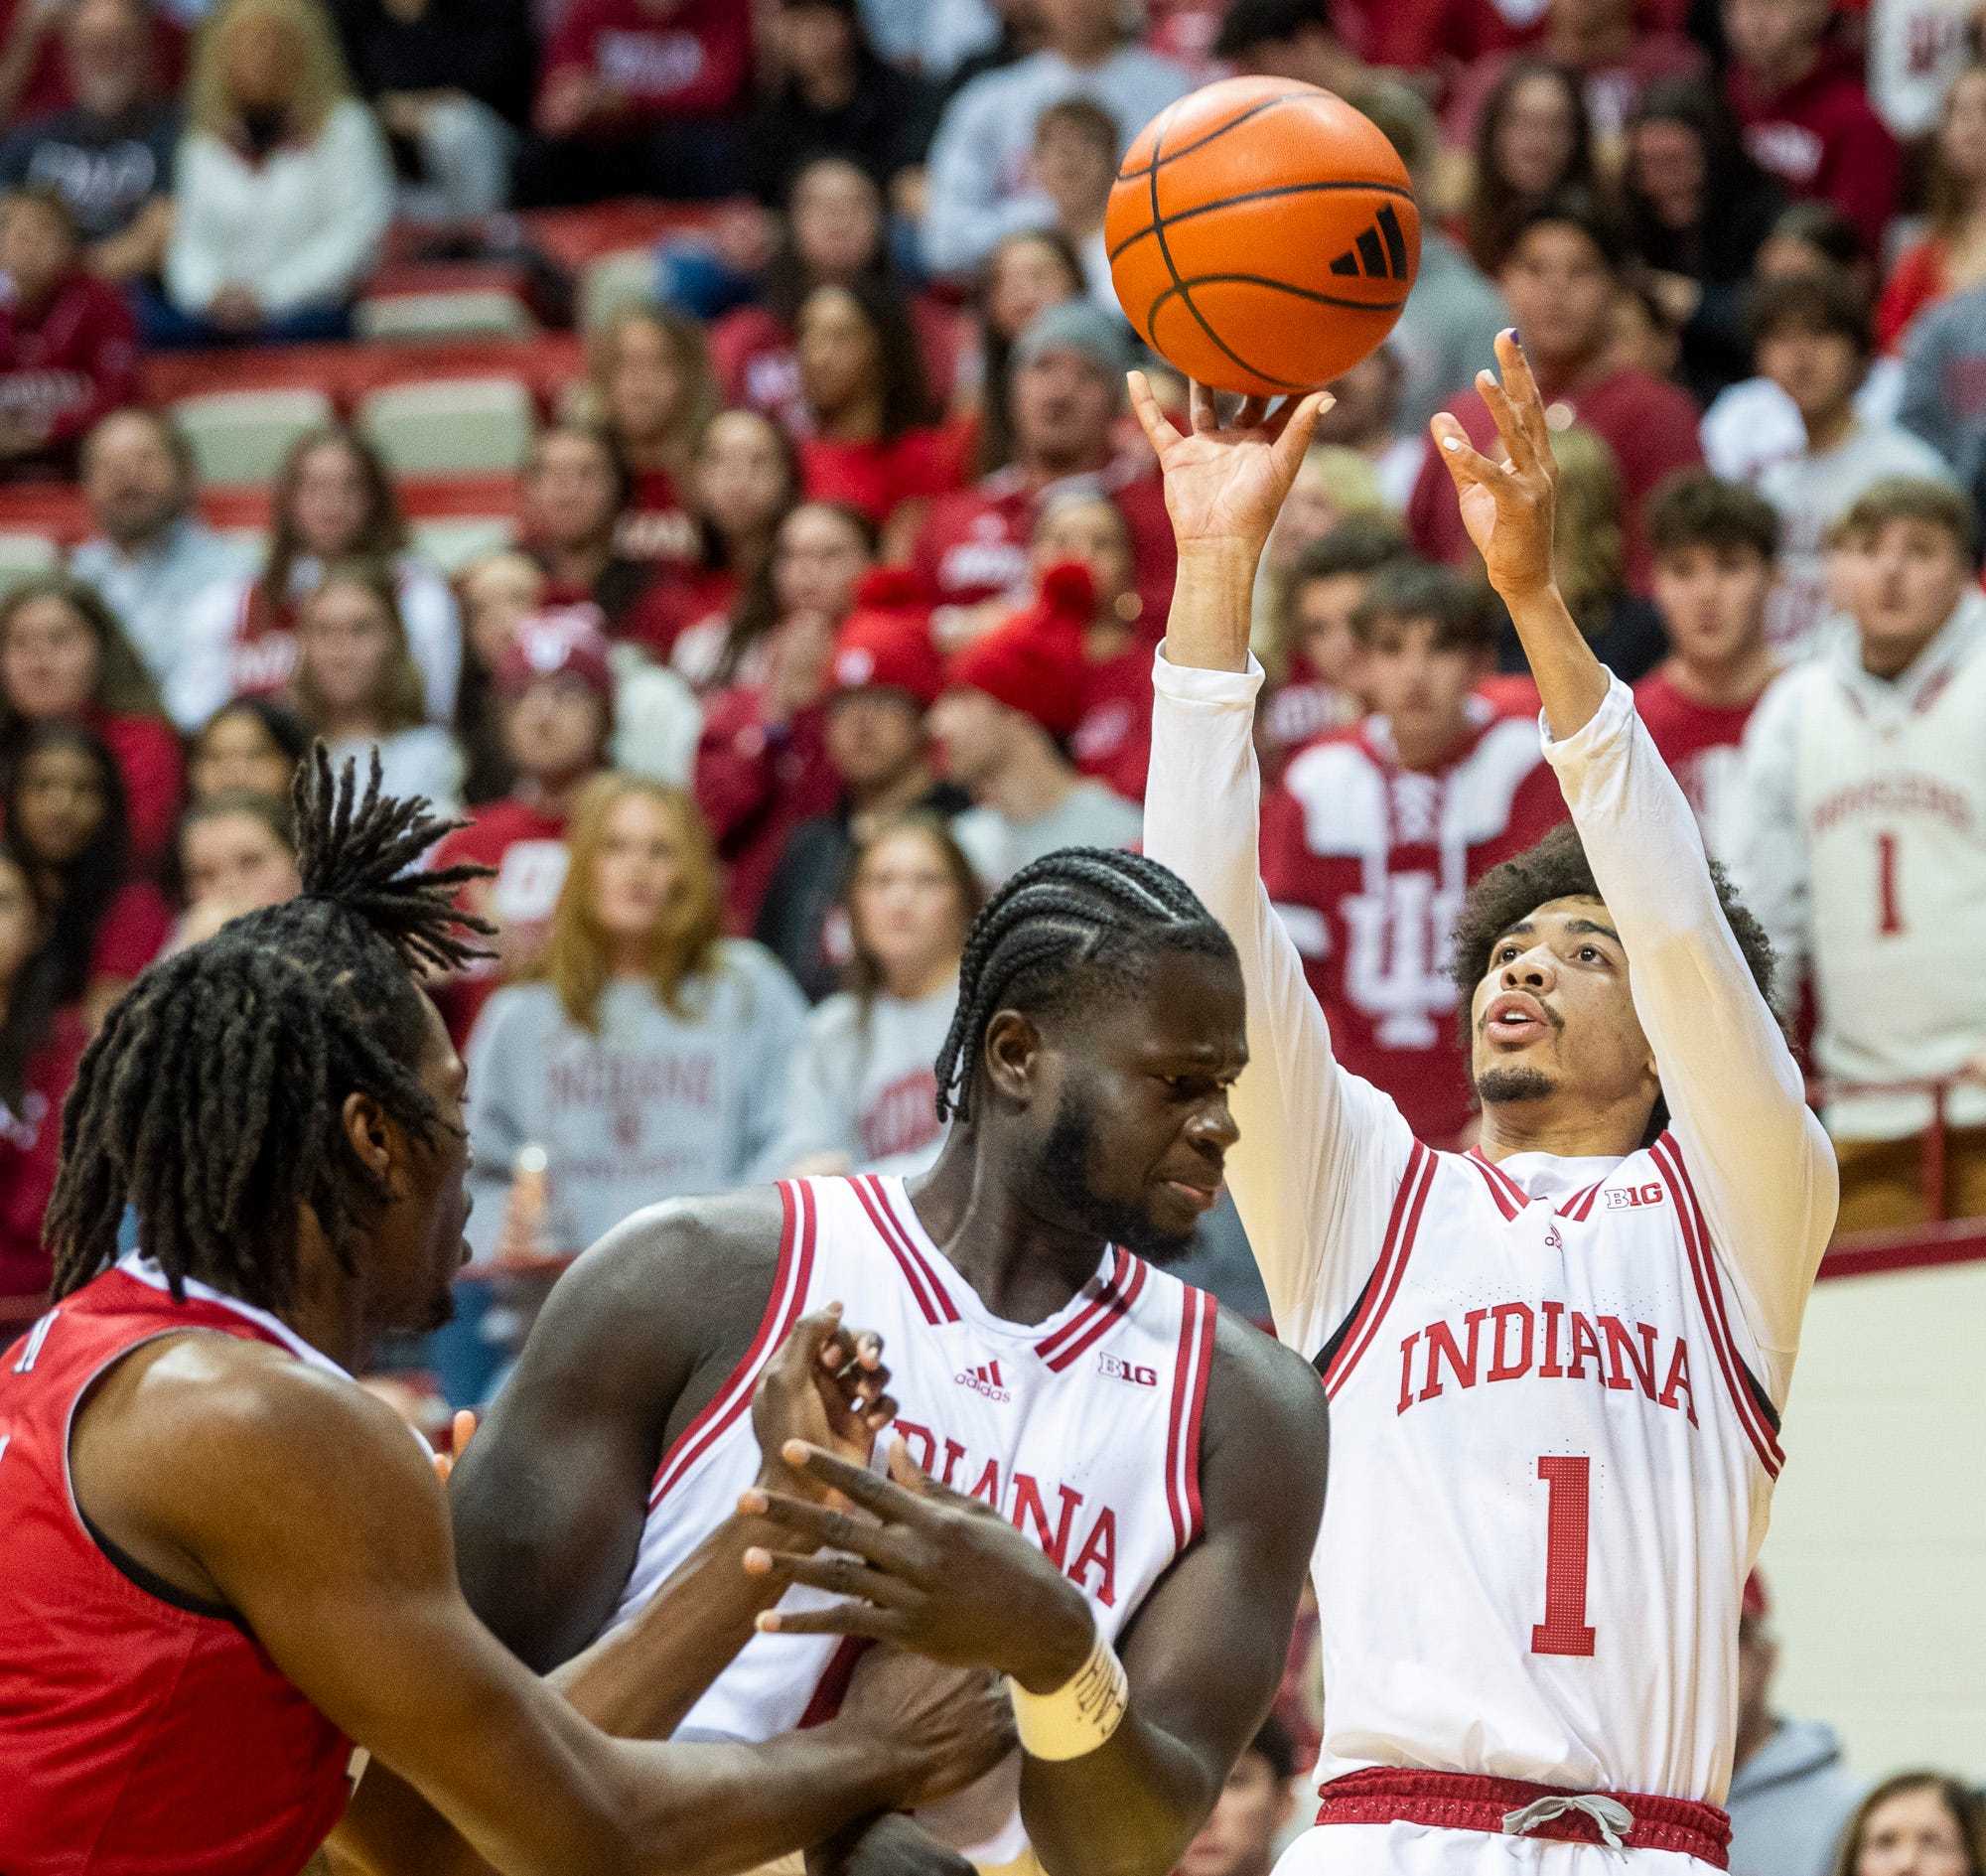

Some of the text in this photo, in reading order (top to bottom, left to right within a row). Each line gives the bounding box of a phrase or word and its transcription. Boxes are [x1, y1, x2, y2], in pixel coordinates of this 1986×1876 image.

[1874, 830, 1909, 939] 1
[953, 1370, 1011, 1403] adidas
[1396, 1300, 1700, 1431] INDIANA
[866, 1417, 1117, 1609] DIANA
[1530, 1455, 1597, 1658] 1
